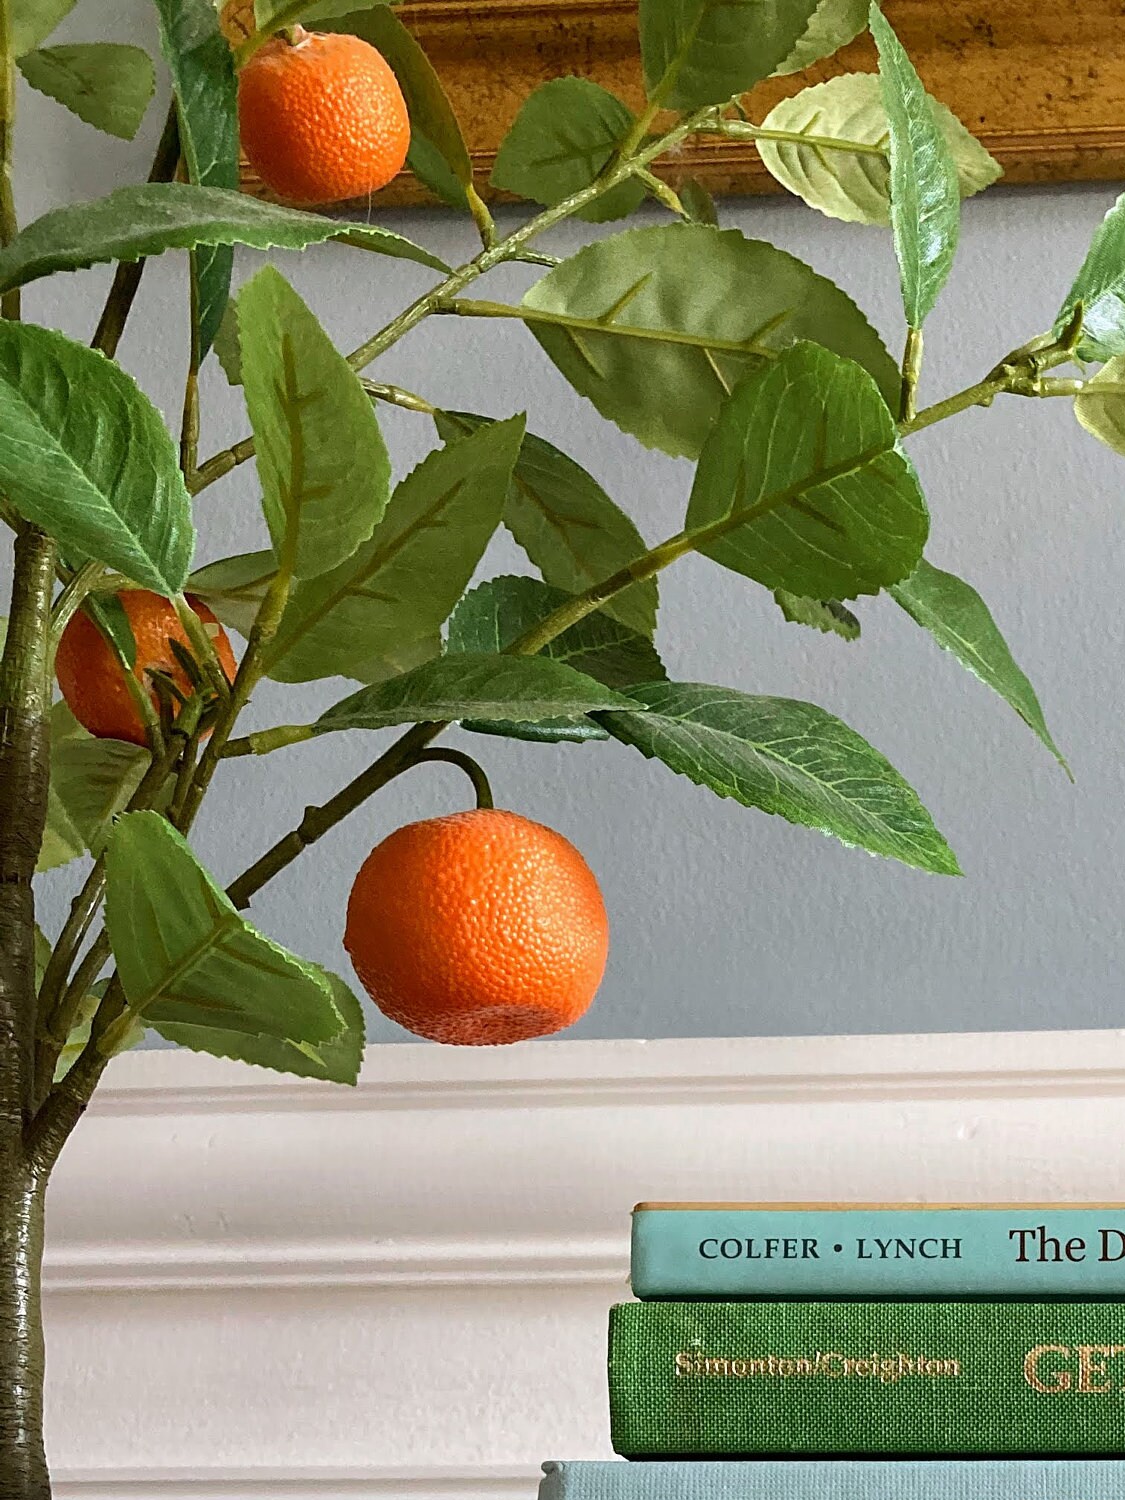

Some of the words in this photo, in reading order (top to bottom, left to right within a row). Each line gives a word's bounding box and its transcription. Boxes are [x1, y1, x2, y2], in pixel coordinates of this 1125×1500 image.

[699, 1237, 819, 1260] COLFER
[857, 1237, 962, 1260] LYNCH
[1009, 1228, 1086, 1264] The
[674, 1349, 961, 1383] Simonton/Creighton
